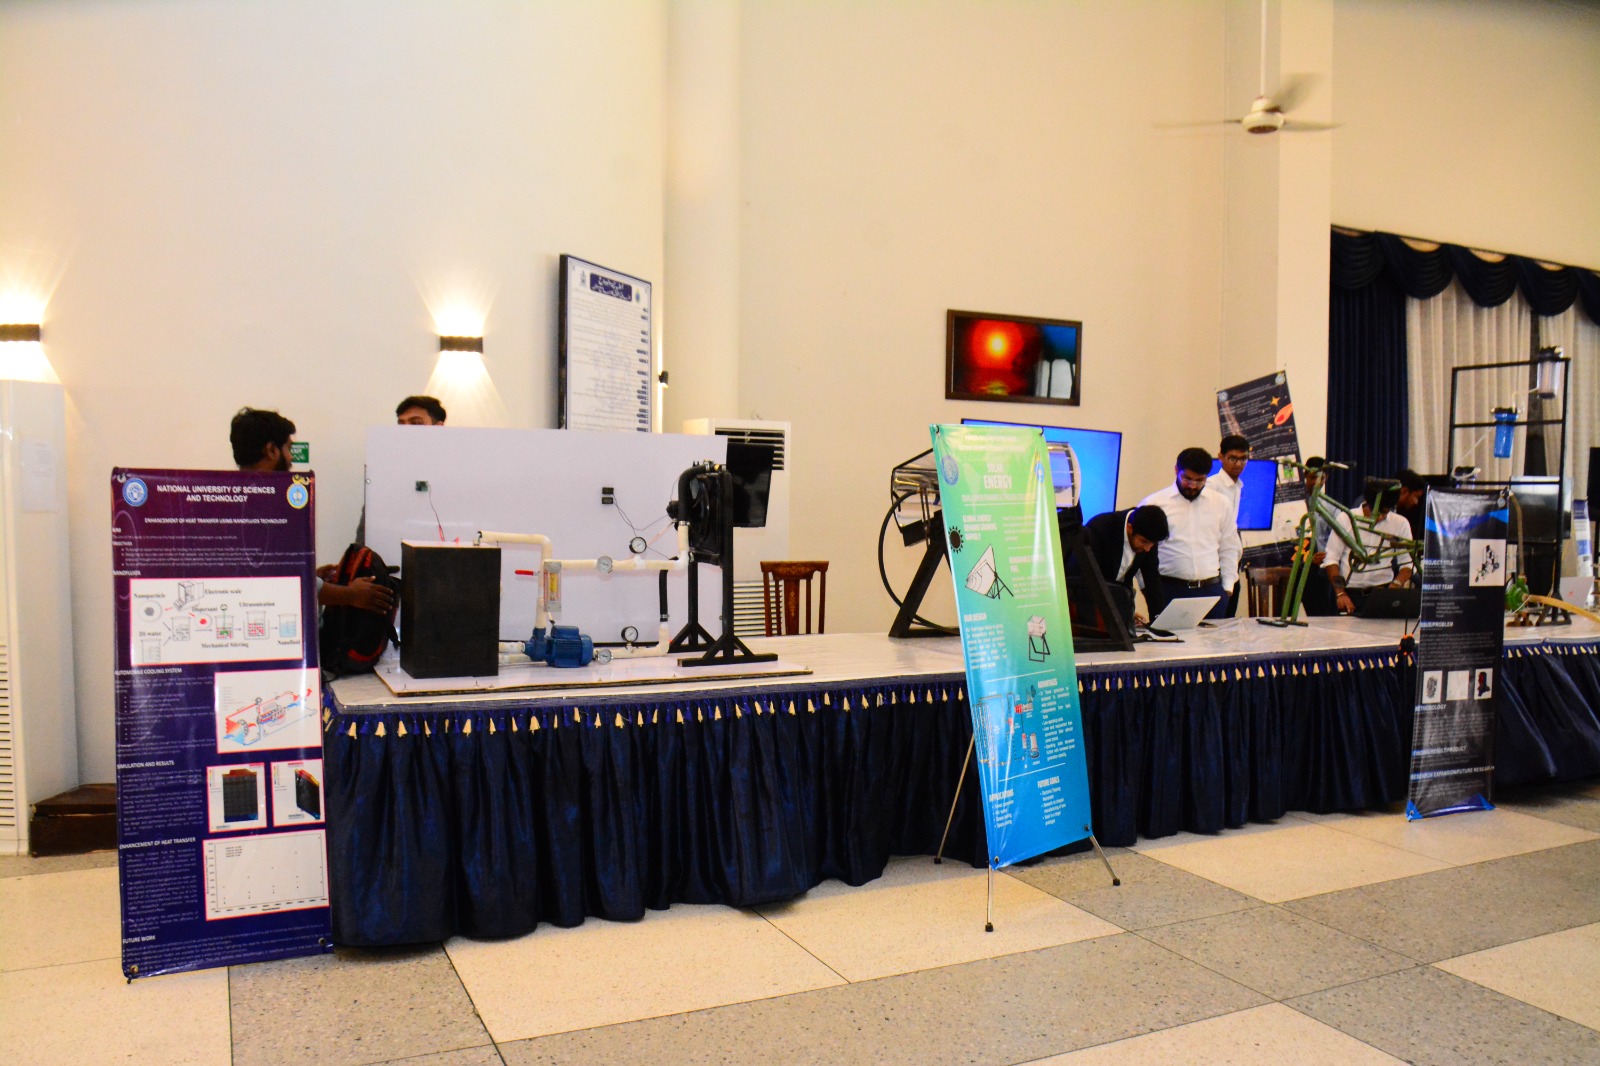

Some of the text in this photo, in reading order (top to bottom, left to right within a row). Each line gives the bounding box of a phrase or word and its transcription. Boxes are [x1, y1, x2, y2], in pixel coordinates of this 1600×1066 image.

[983, 475, 1012, 489] ENERGY
[157, 485, 191, 493] NATIONAL
[192, 486, 231, 494] UNIVERSITY
[243, 486, 275, 494] SCIENCES
[186, 494, 201, 502] AND
[117, 761, 145, 770] SIMULATION
[1410, 771, 1433, 780] RESEARCH
[119, 841, 154, 849] ENHANCEMENT
[173, 836, 196, 844] TRANSFER
